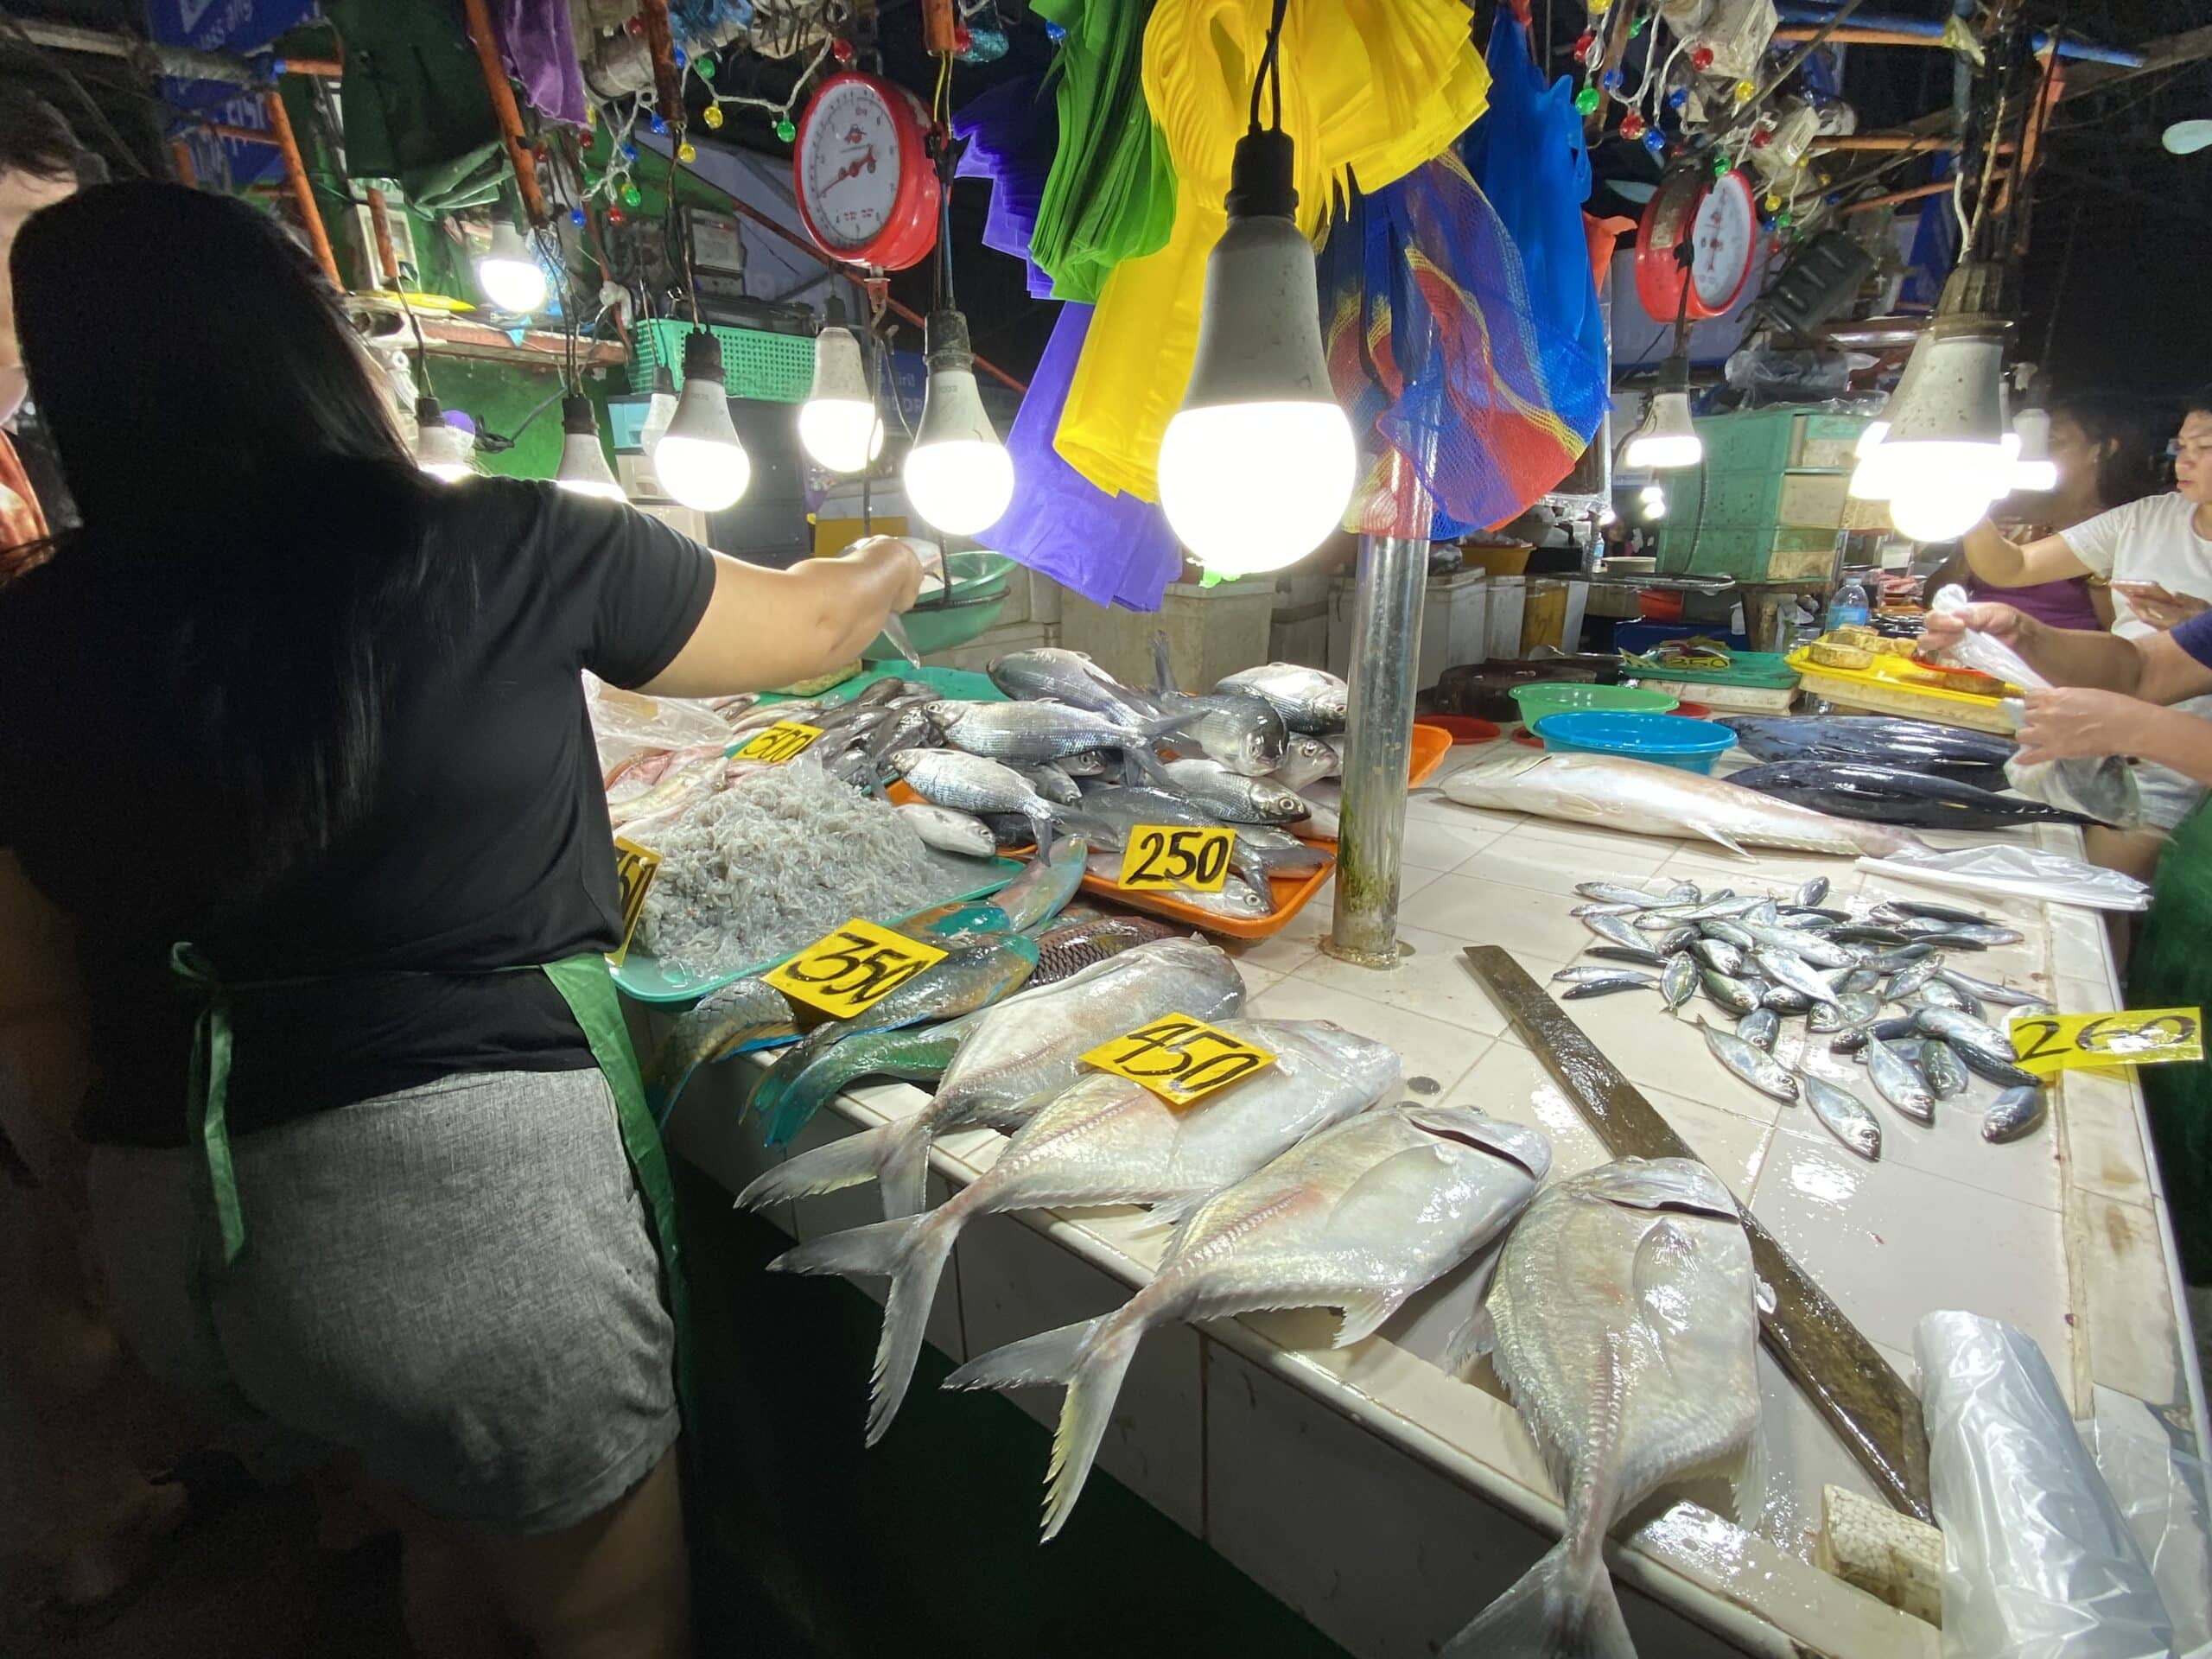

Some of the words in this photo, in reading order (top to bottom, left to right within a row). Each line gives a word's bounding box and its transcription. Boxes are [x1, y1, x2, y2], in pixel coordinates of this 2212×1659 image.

[743, 727, 812, 762] 300
[1125, 830, 1229, 885] 250
[785, 931, 931, 1005] 350
[1113, 1023, 1261, 1093] 450
[2014, 1015, 2197, 1063] 260
